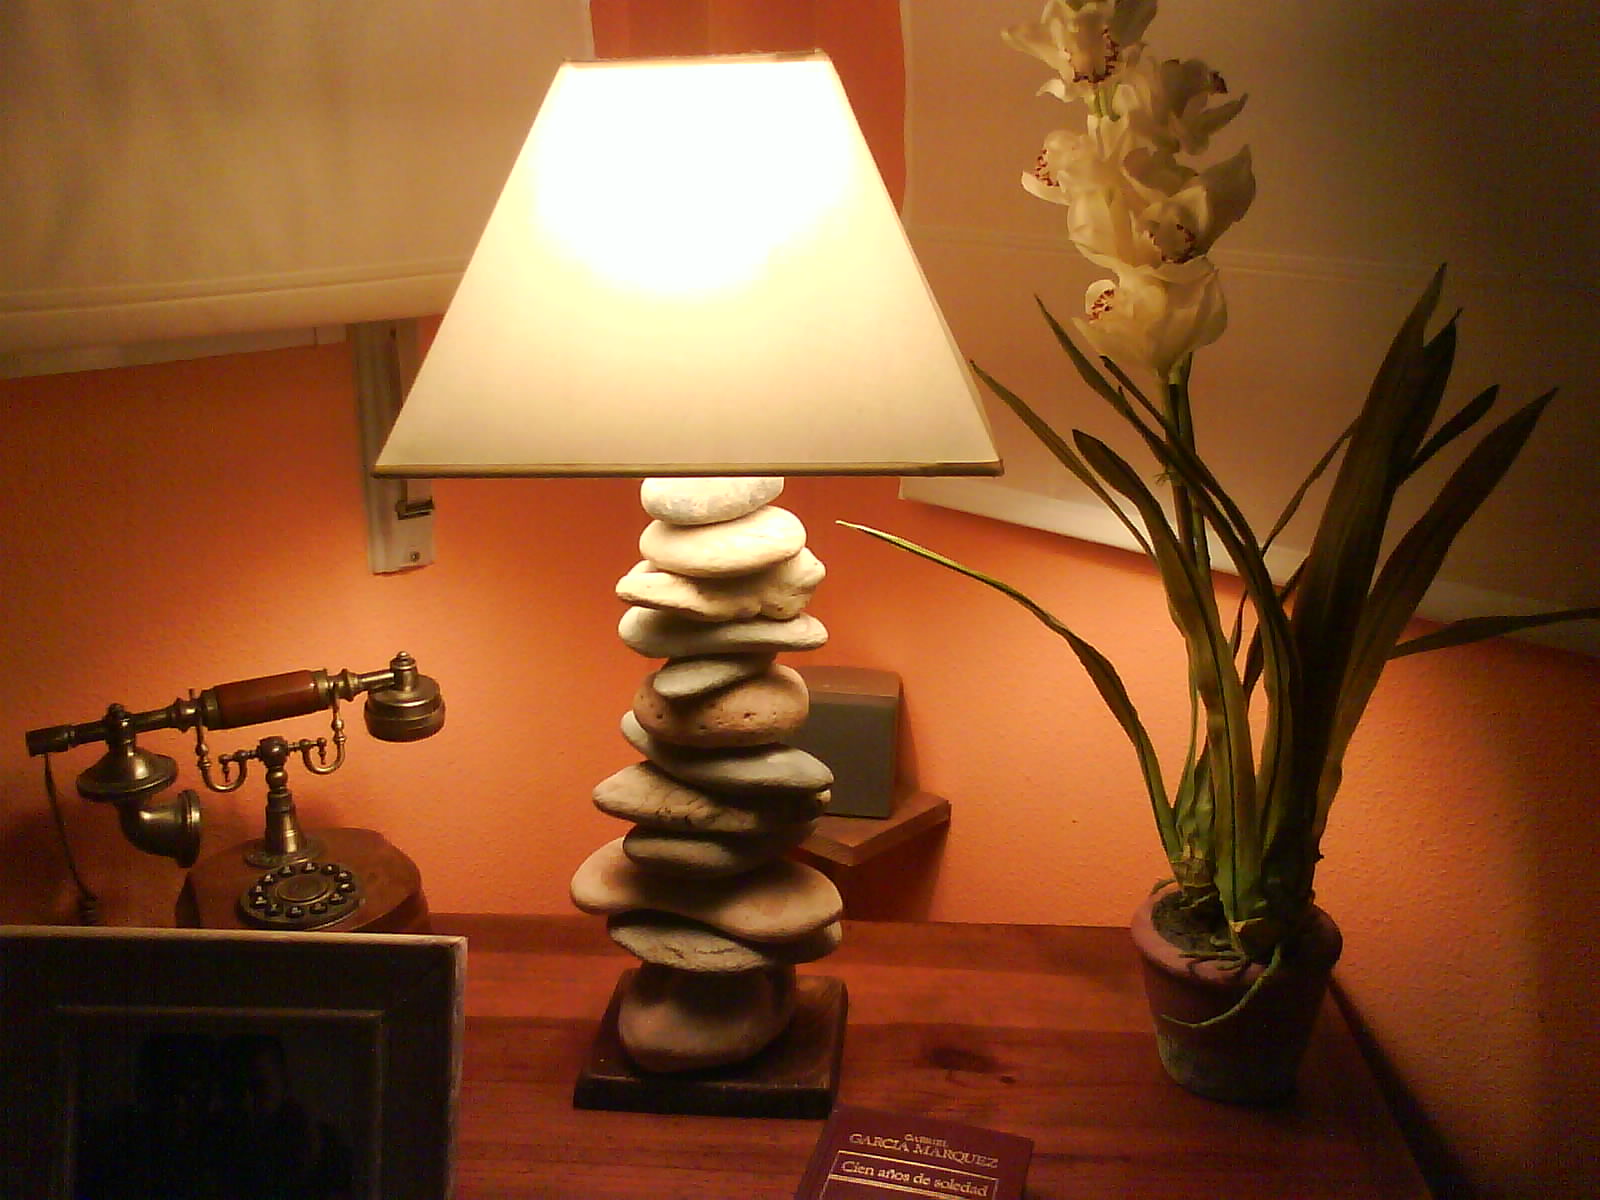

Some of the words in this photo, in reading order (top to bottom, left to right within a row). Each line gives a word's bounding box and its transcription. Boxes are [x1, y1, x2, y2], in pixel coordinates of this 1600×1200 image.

[842, 1160, 875, 1177] Cien
[878, 1168, 910, 1183] años
[913, 1172, 931, 1187] de
[934, 1178, 988, 1197] soledad
